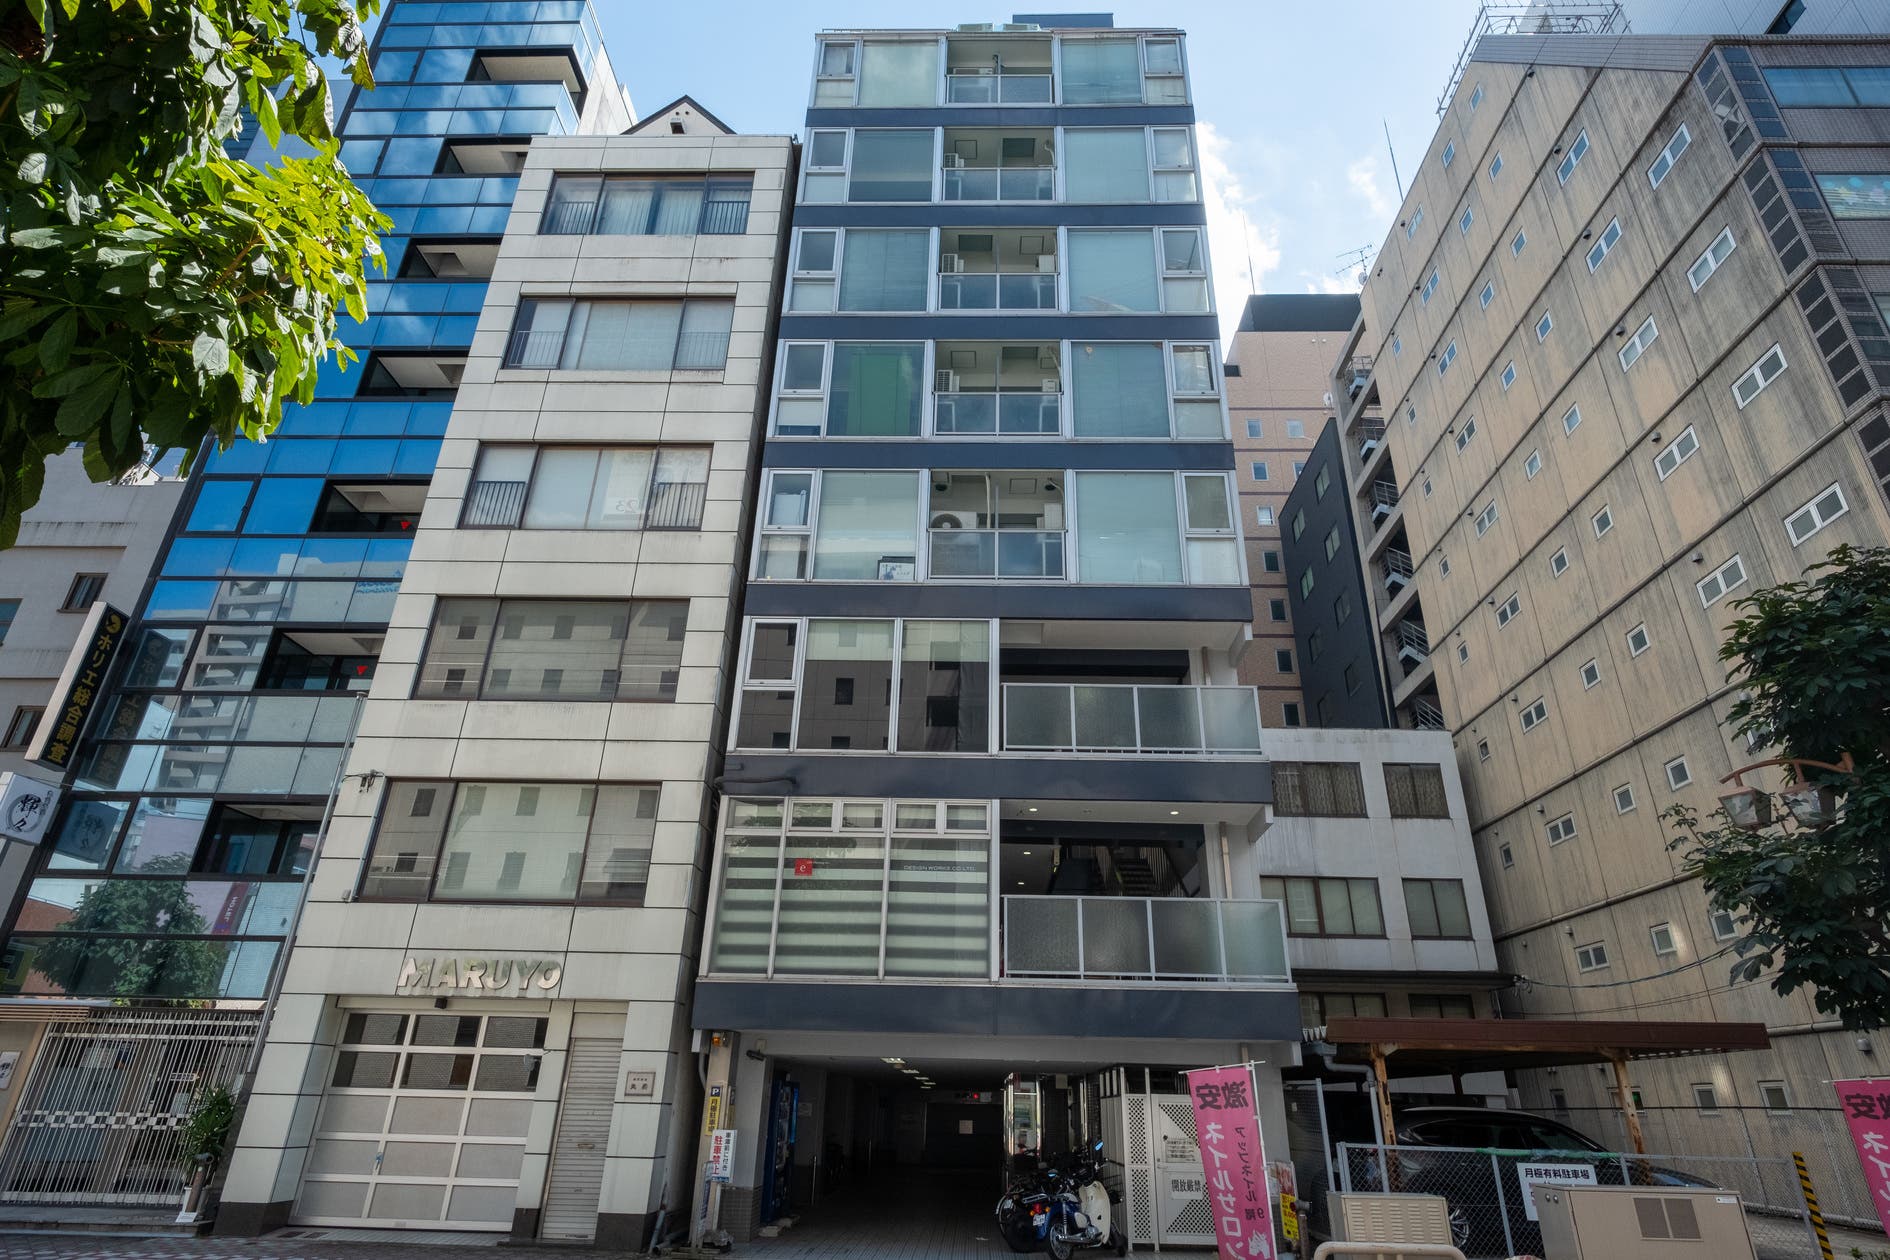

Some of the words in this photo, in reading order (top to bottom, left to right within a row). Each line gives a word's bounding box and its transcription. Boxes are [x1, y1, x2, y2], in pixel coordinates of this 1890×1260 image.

[47, 634, 113, 765] ホリエ総合調査
[397, 957, 562, 990] MARUYO
[712, 1135, 723, 1175] 駐車禁止
[1171, 1179, 1202, 1192] 開放厳禁
[1524, 1167, 1590, 1179] 月極有料駐車場
